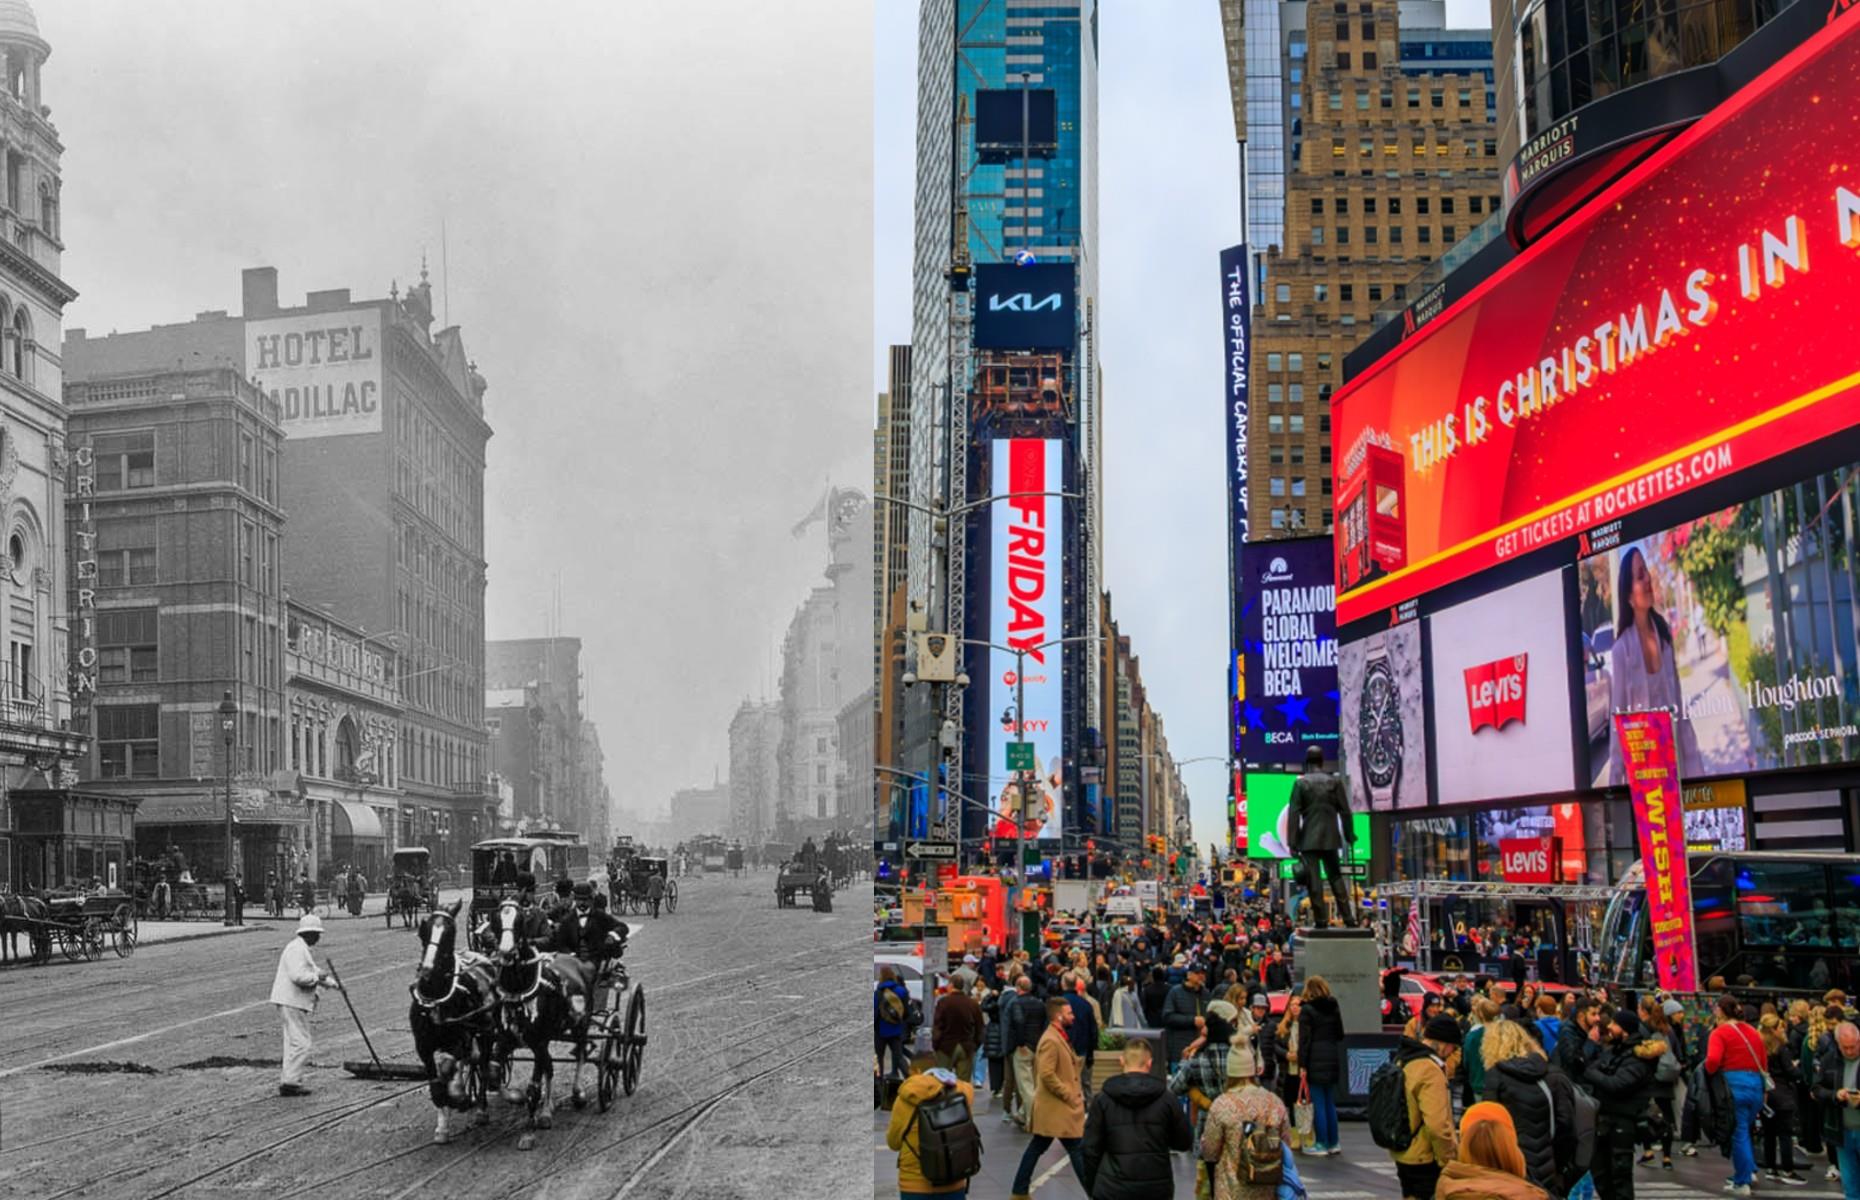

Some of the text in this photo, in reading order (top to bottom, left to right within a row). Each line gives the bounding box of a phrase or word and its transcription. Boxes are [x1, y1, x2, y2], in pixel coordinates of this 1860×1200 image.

[1521, 116, 1578, 165] MARRIOTT
[1522, 141, 1571, 184] MARQUIS
[1227, 264, 1242, 309] THE
[257, 325, 372, 369] HOTEL
[1231, 314, 1246, 395] OFFICIAL
[1411, 413, 1458, 472] THIS
[1465, 396, 1489, 445] IS
[1498, 268, 1716, 426] CHRISTMAS
[1738, 215, 1807, 300] IN
[270, 380, 376, 420] ADILLAC
[1495, 443, 1733, 558] GET TICKETS AT ROCKETTES.COM
[76, 447, 97, 692] CRITERION
[1008, 497, 1045, 665] FRIDAY
[1262, 585, 1336, 616] PARAMOU
[1263, 613, 1317, 643] GLOBAL
[1264, 669, 1302, 697] BECA
[1747, 673, 1840, 711] Houghton
[1265, 731, 1294, 744] BECA
[1645, 785, 1673, 904] WISH
